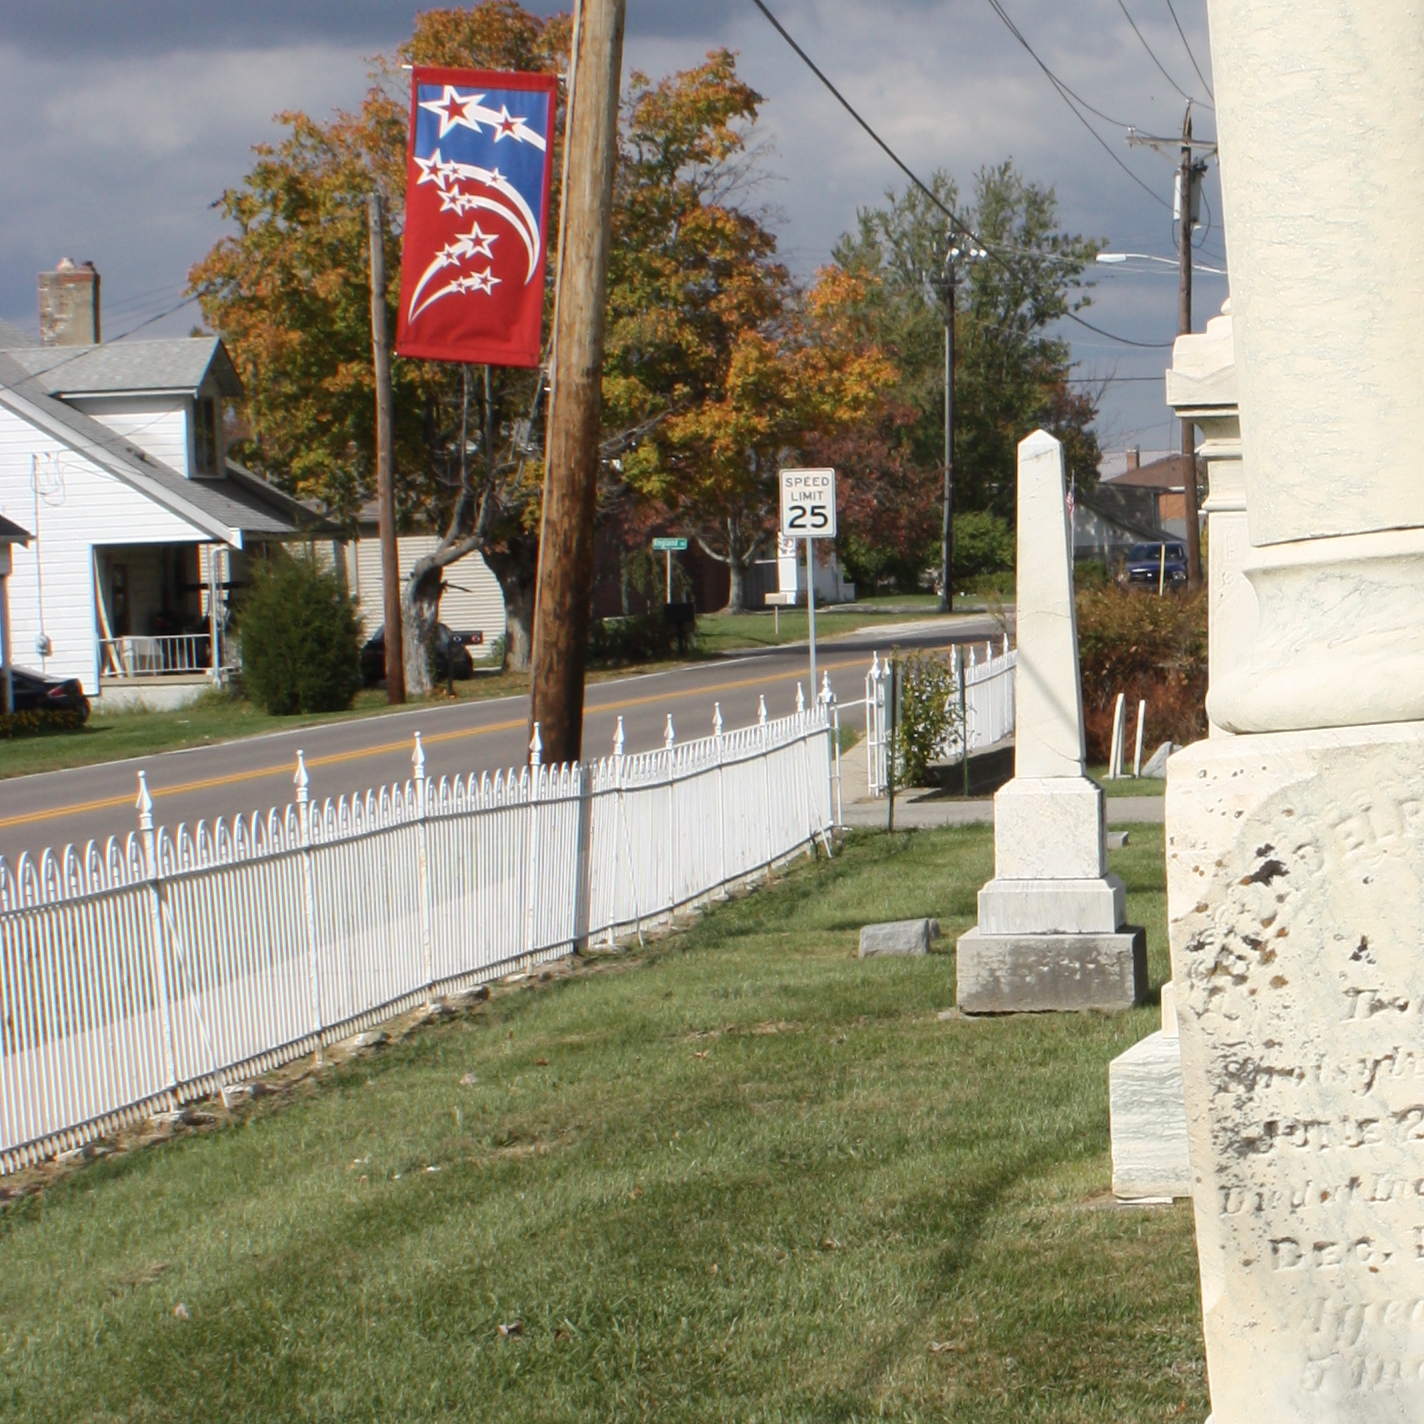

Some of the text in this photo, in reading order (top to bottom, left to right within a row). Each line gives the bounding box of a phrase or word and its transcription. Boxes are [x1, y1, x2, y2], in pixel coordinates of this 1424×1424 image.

[785, 477, 830, 488] SPEED
[790, 490, 825, 502] LIMIT
[788, 505, 829, 529] 25
